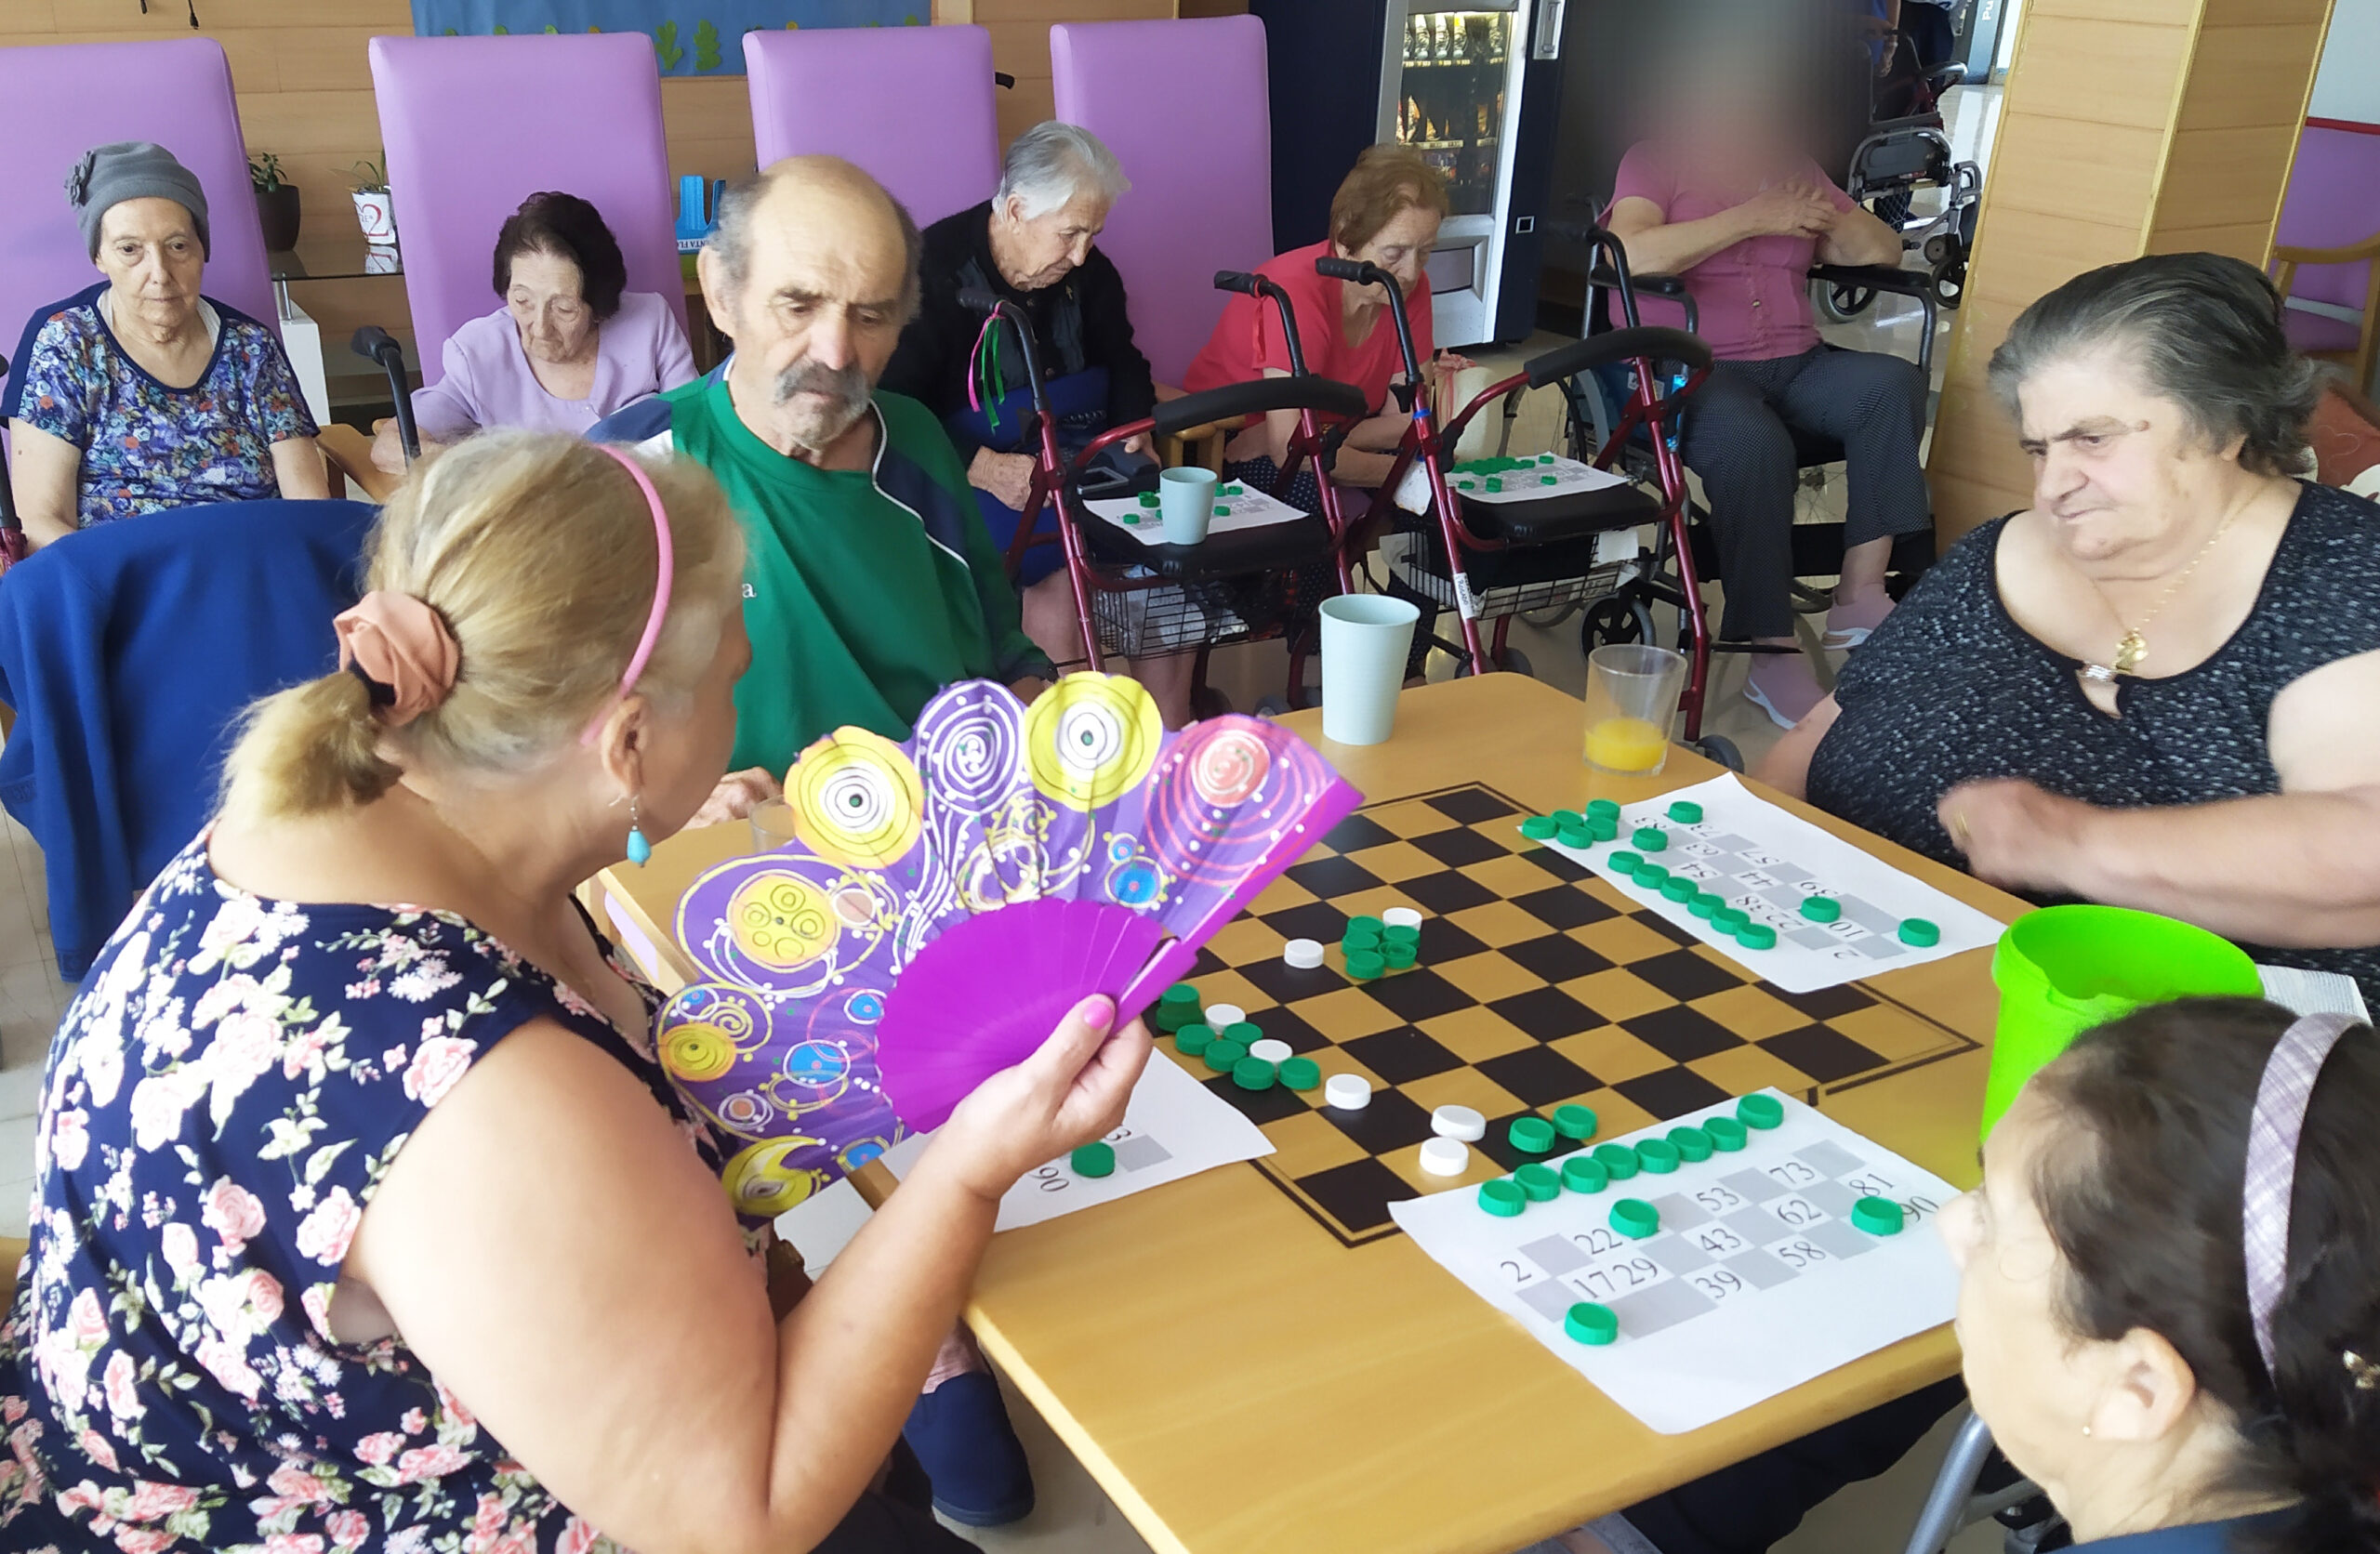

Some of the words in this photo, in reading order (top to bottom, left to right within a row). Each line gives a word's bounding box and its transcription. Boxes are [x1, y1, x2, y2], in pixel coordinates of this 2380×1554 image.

[1690, 823, 1722, 837] 73
[1741, 850, 1780, 864] 57
[1680, 863, 1718, 878] 54
[1739, 872, 1774, 887] 44
[1828, 921, 1865, 938] 10
[1833, 949, 1859, 960] 2
[1026, 1166, 1070, 1193] 90
[1500, 1259, 1532, 1283] 2
[1574, 1228, 1623, 1255] 22
[1696, 1187, 1740, 1212] 53
[1768, 1162, 1816, 1184] 73
[1573, 1270, 1616, 1298] 17
[1612, 1258, 1658, 1285] 29
[1699, 1228, 1741, 1252] 43
[1777, 1199, 1822, 1225] 62
[1848, 1173, 1896, 1197] 81
[1695, 1271, 1742, 1299] 39
[1778, 1241, 1827, 1268] 58
[1897, 1195, 1940, 1222] 90
